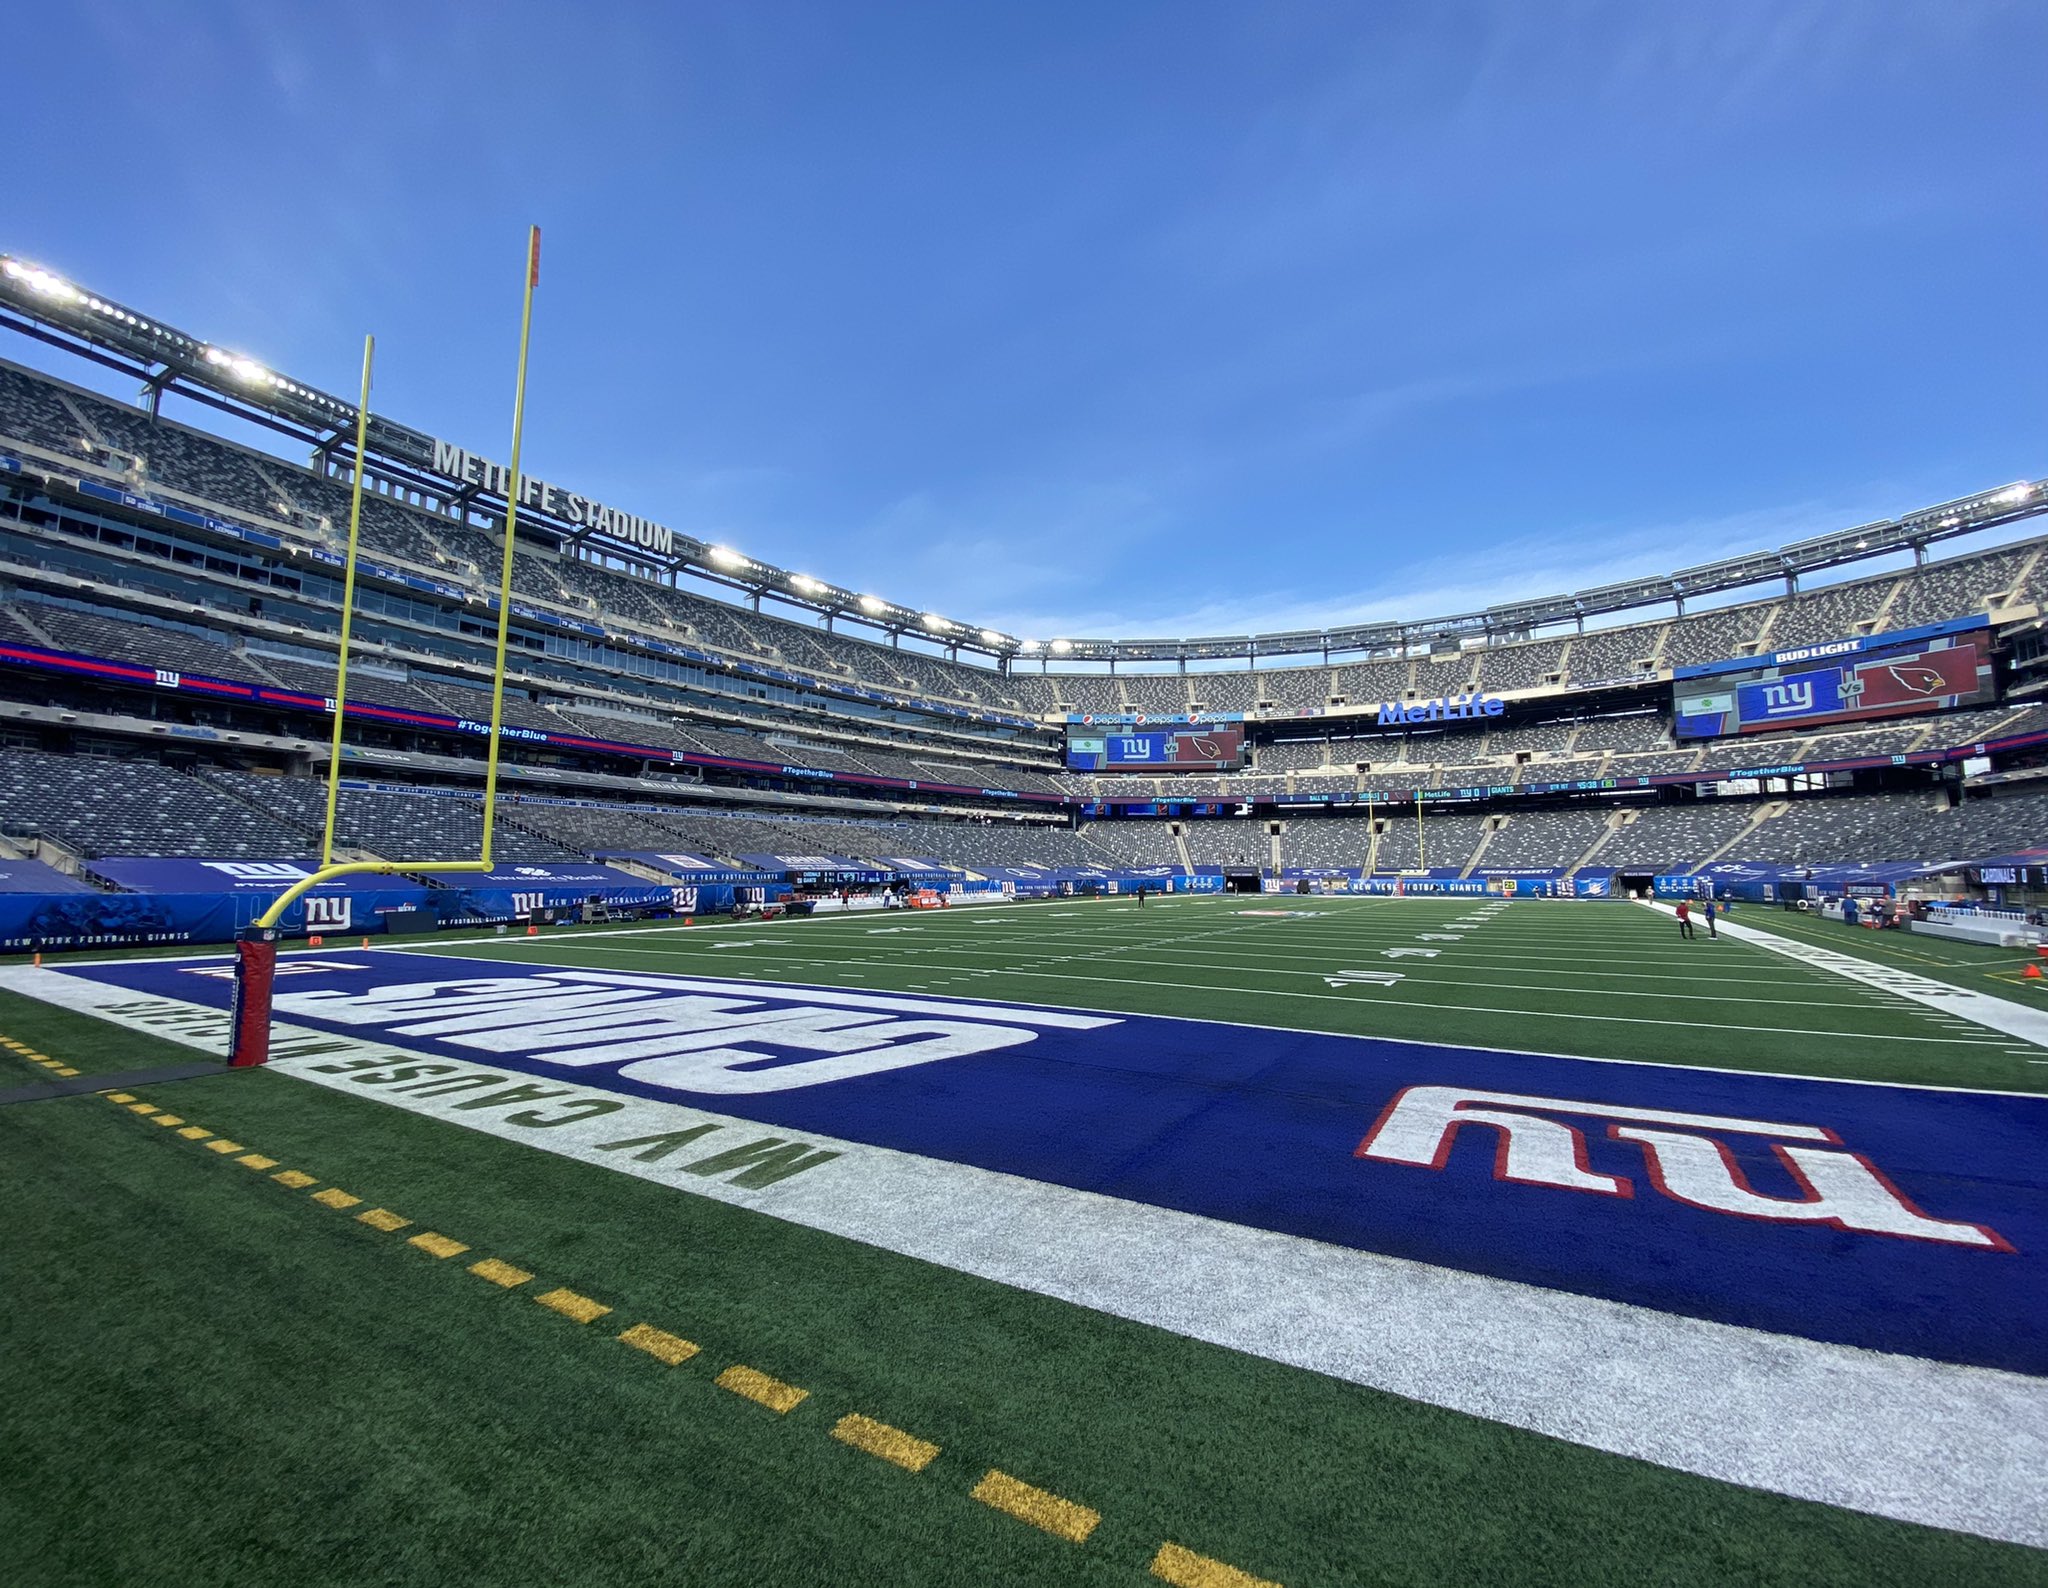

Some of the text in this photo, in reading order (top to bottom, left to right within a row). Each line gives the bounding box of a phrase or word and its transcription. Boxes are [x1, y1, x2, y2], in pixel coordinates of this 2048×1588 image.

[433, 438, 672, 555] METLIFE STADIUM
[1775, 640, 1861, 664] BUD LIGHT
[155, 669, 180, 688] ny
[324, 698, 337, 713] n
[1762, 681, 1813, 714] ny
[1377, 692, 1505, 726] MetLife
[458, 720, 548, 741] #TogherBlue
[1121, 738, 1150, 759] ny
[782, 767, 834, 778] #TogetherBlue
[1729, 765, 1805, 777] #TogetherBlue
[1424, 790, 1451, 798] MetLife
[1491, 786, 1514, 794] GIANTS
[1353, 883, 1371, 891] NEW
[1449, 883, 1482, 891] GIANTS
[602, 896, 639, 904] OOTBALL
[305, 897, 352, 932] ny
[5, 931, 190, 947] NEW YORK FOOTBALL GIANTS
[307, 1063, 625, 1130] CAUSE
[594, 1124, 844, 1191] MY
[1354, 1085, 2018, 1254] ny
